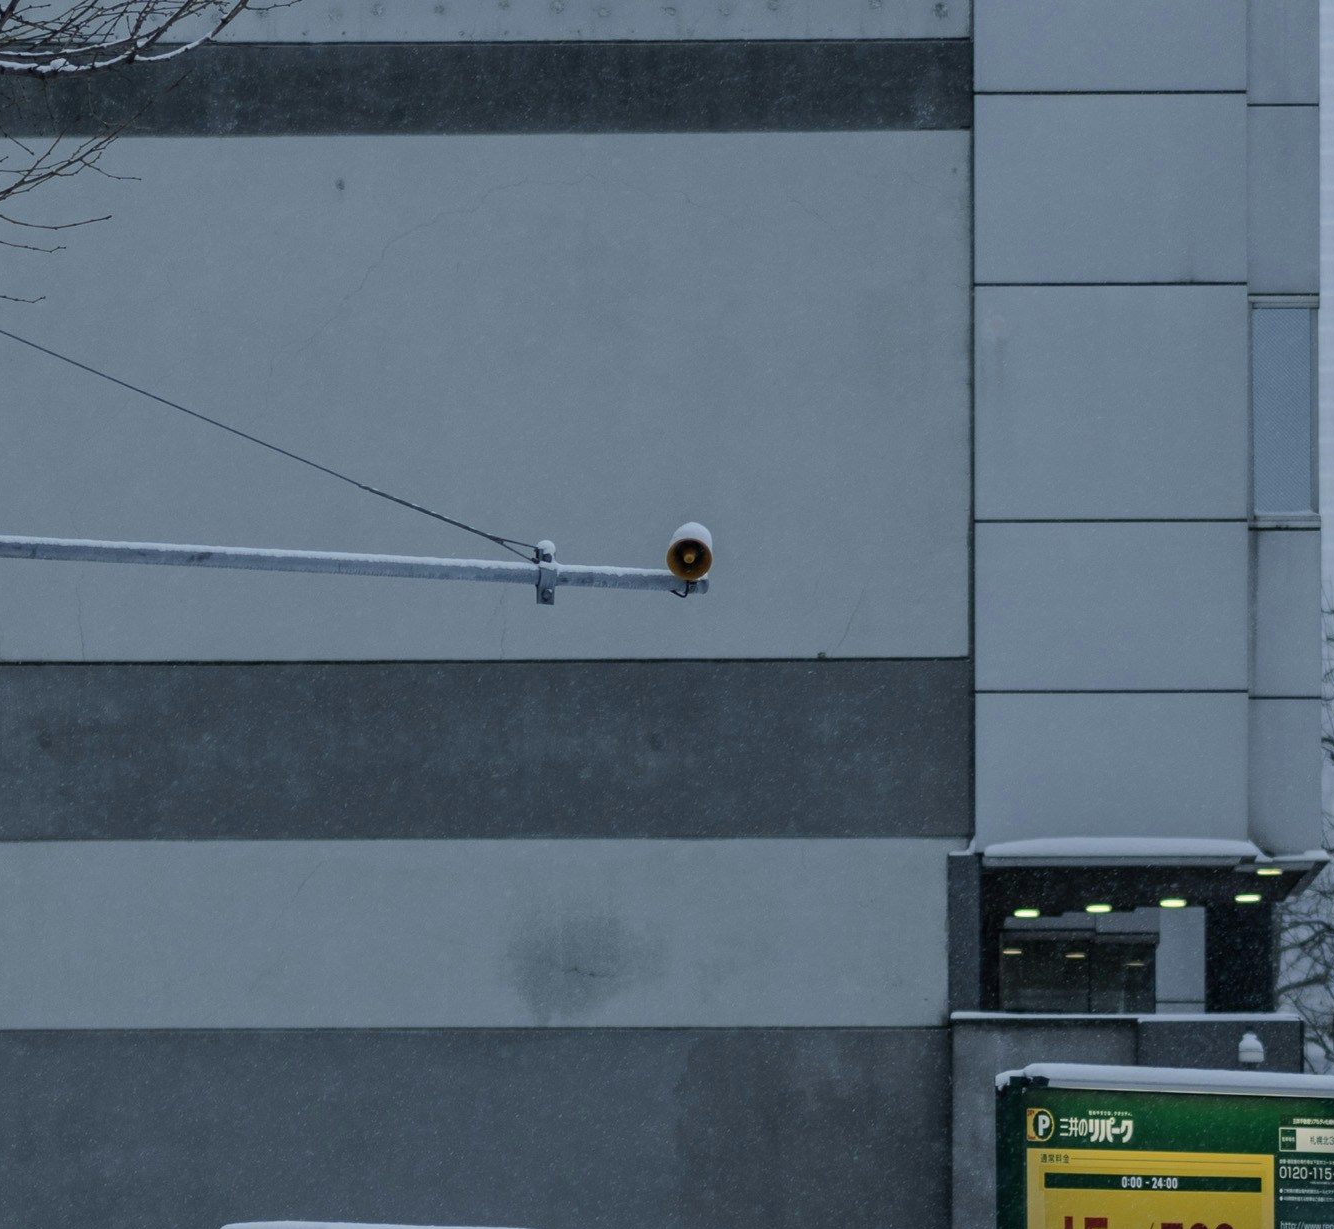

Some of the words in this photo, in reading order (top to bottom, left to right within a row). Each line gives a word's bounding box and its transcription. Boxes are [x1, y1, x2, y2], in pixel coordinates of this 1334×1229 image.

[1060, 1117, 1133, 1142] 三井のリパーク
[1040, 1154, 1070, 1163] 通常料金
[1121, 1177, 1144, 1189] 0:00
[1152, 1178, 1178, 1190] 24:00
